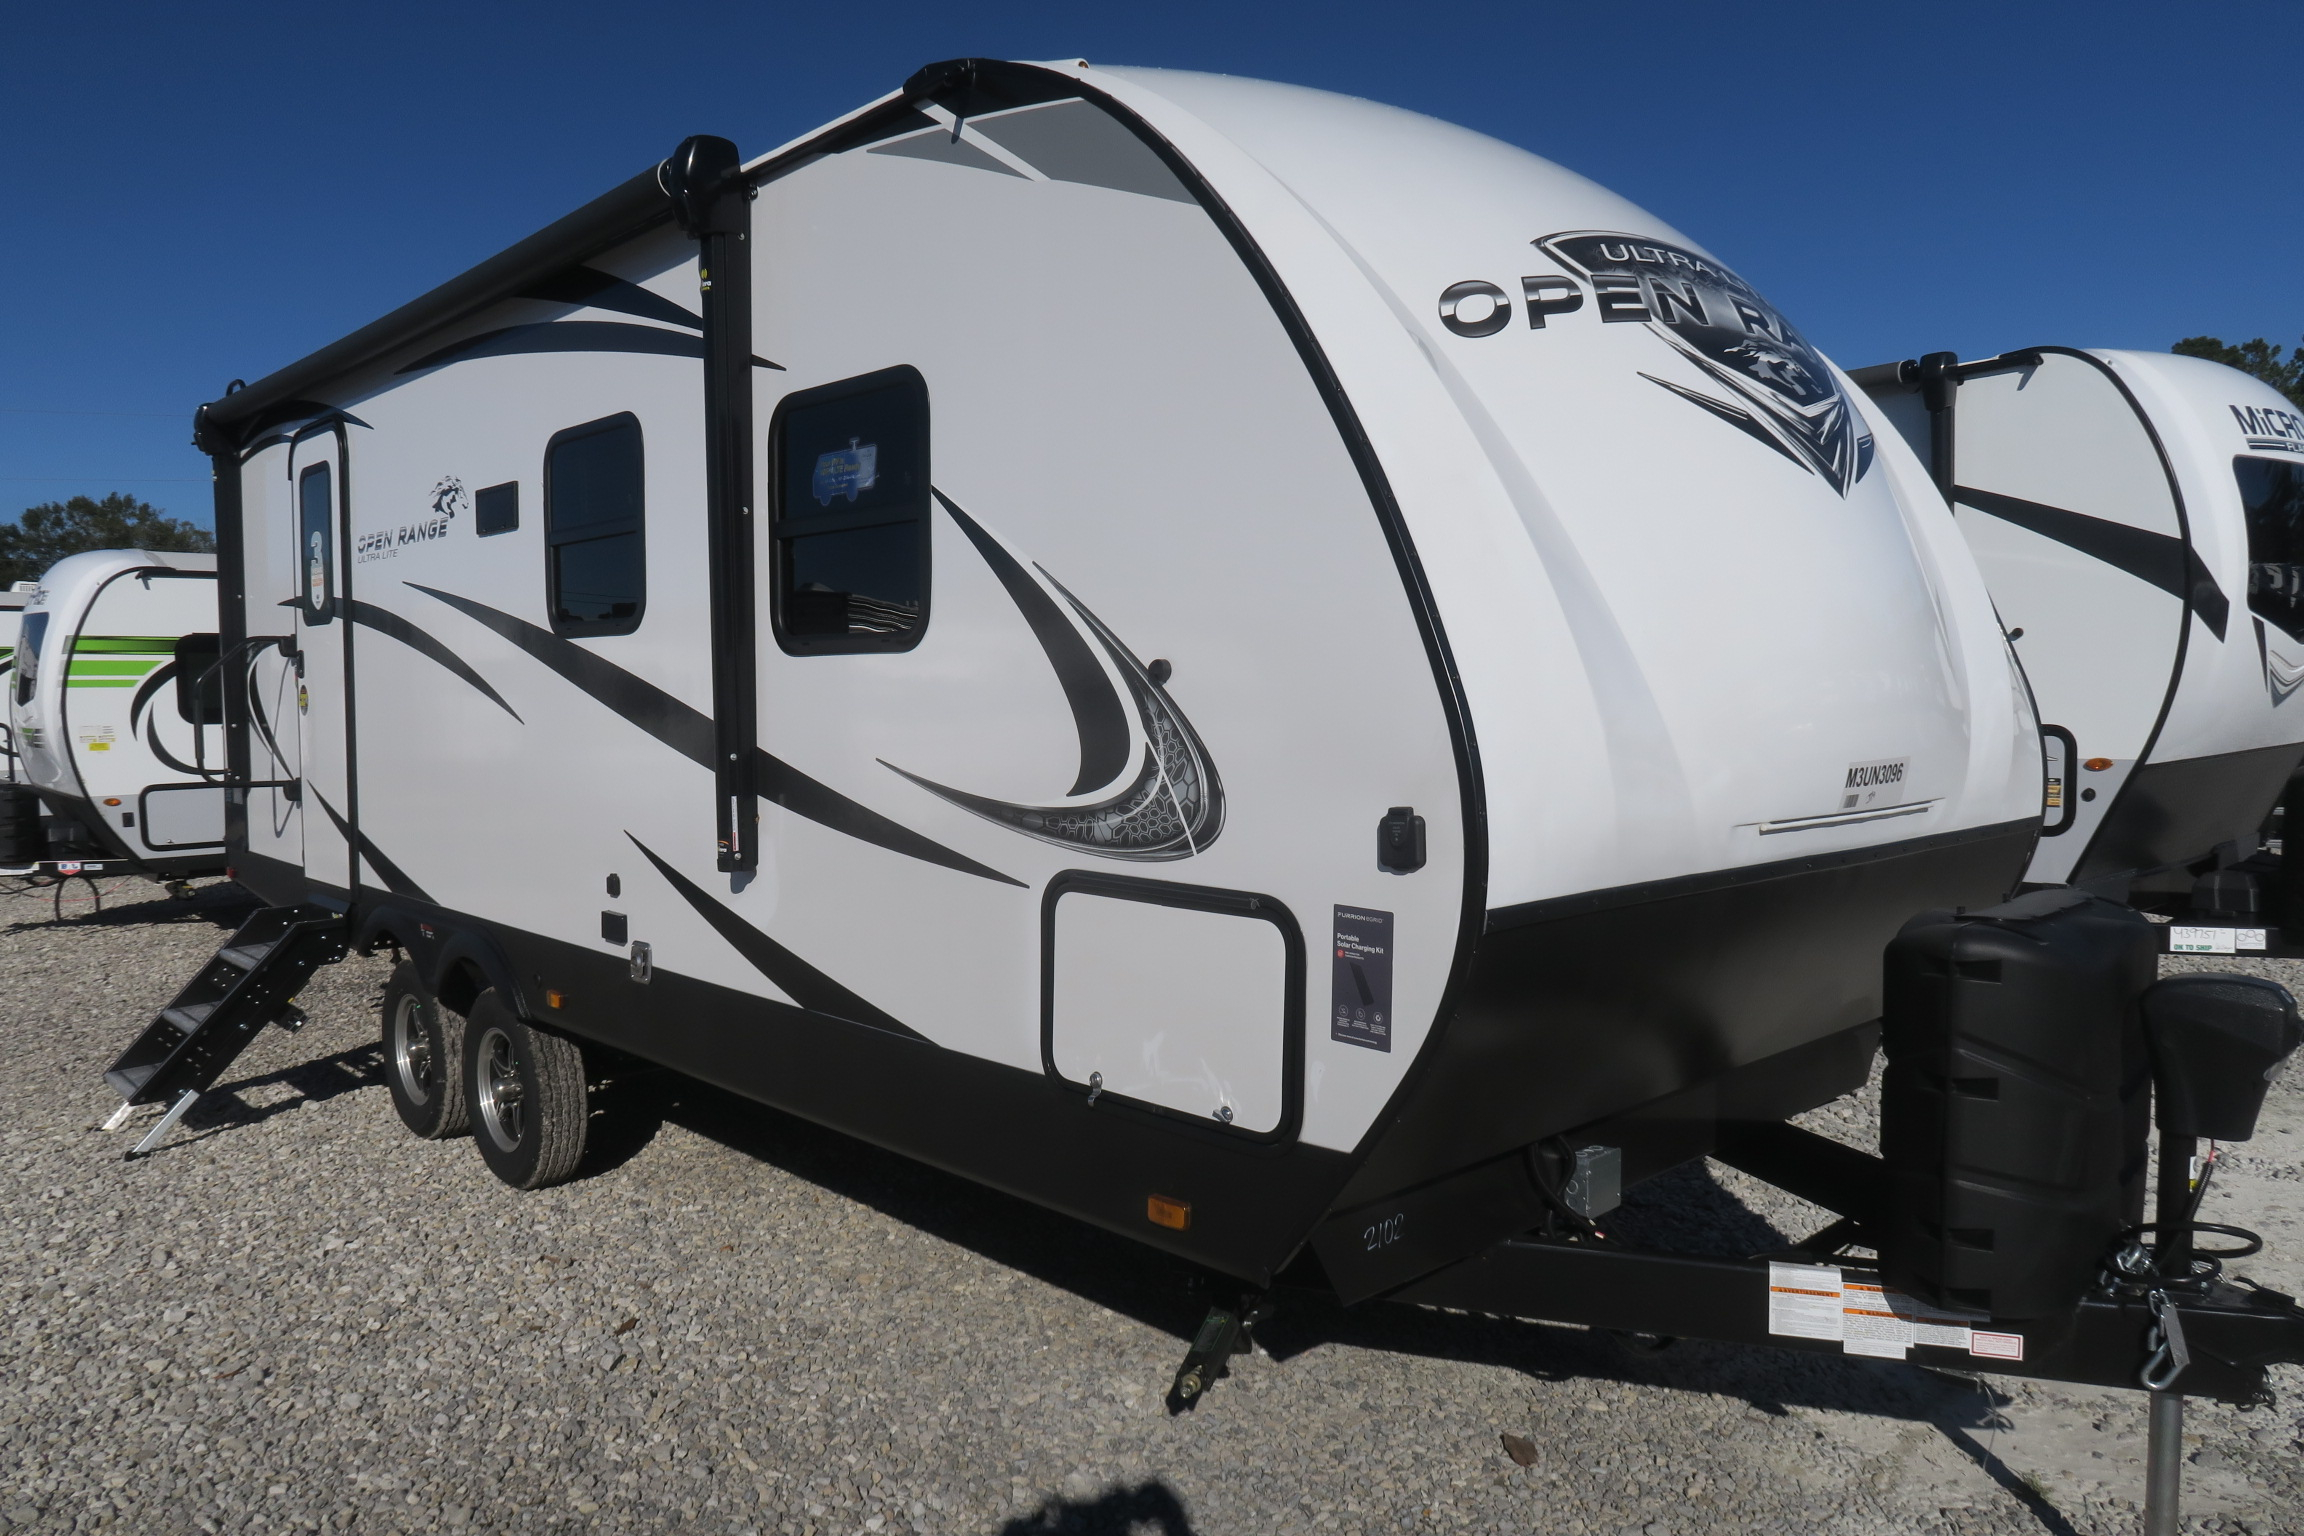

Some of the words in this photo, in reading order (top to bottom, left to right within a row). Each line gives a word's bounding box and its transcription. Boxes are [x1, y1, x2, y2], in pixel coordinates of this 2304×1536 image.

[1600, 243, 1714, 276] ULTRA
[1438, 274, 1710, 338] OPEN
[358, 530, 393, 554] OPEN
[398, 517, 448, 545] RANGE
[357, 551, 381, 564] ULTRA
[382, 549, 398, 560] LITE
[1844, 762, 1904, 788] M3UN3096
[1337, 933, 1359, 942] Portable
[1337, 940, 1351, 948] Solar
[1351, 943, 1375, 953] Charging
[1376, 946, 1384, 954] Kit
[1364, 1213, 1404, 1251] 2102
